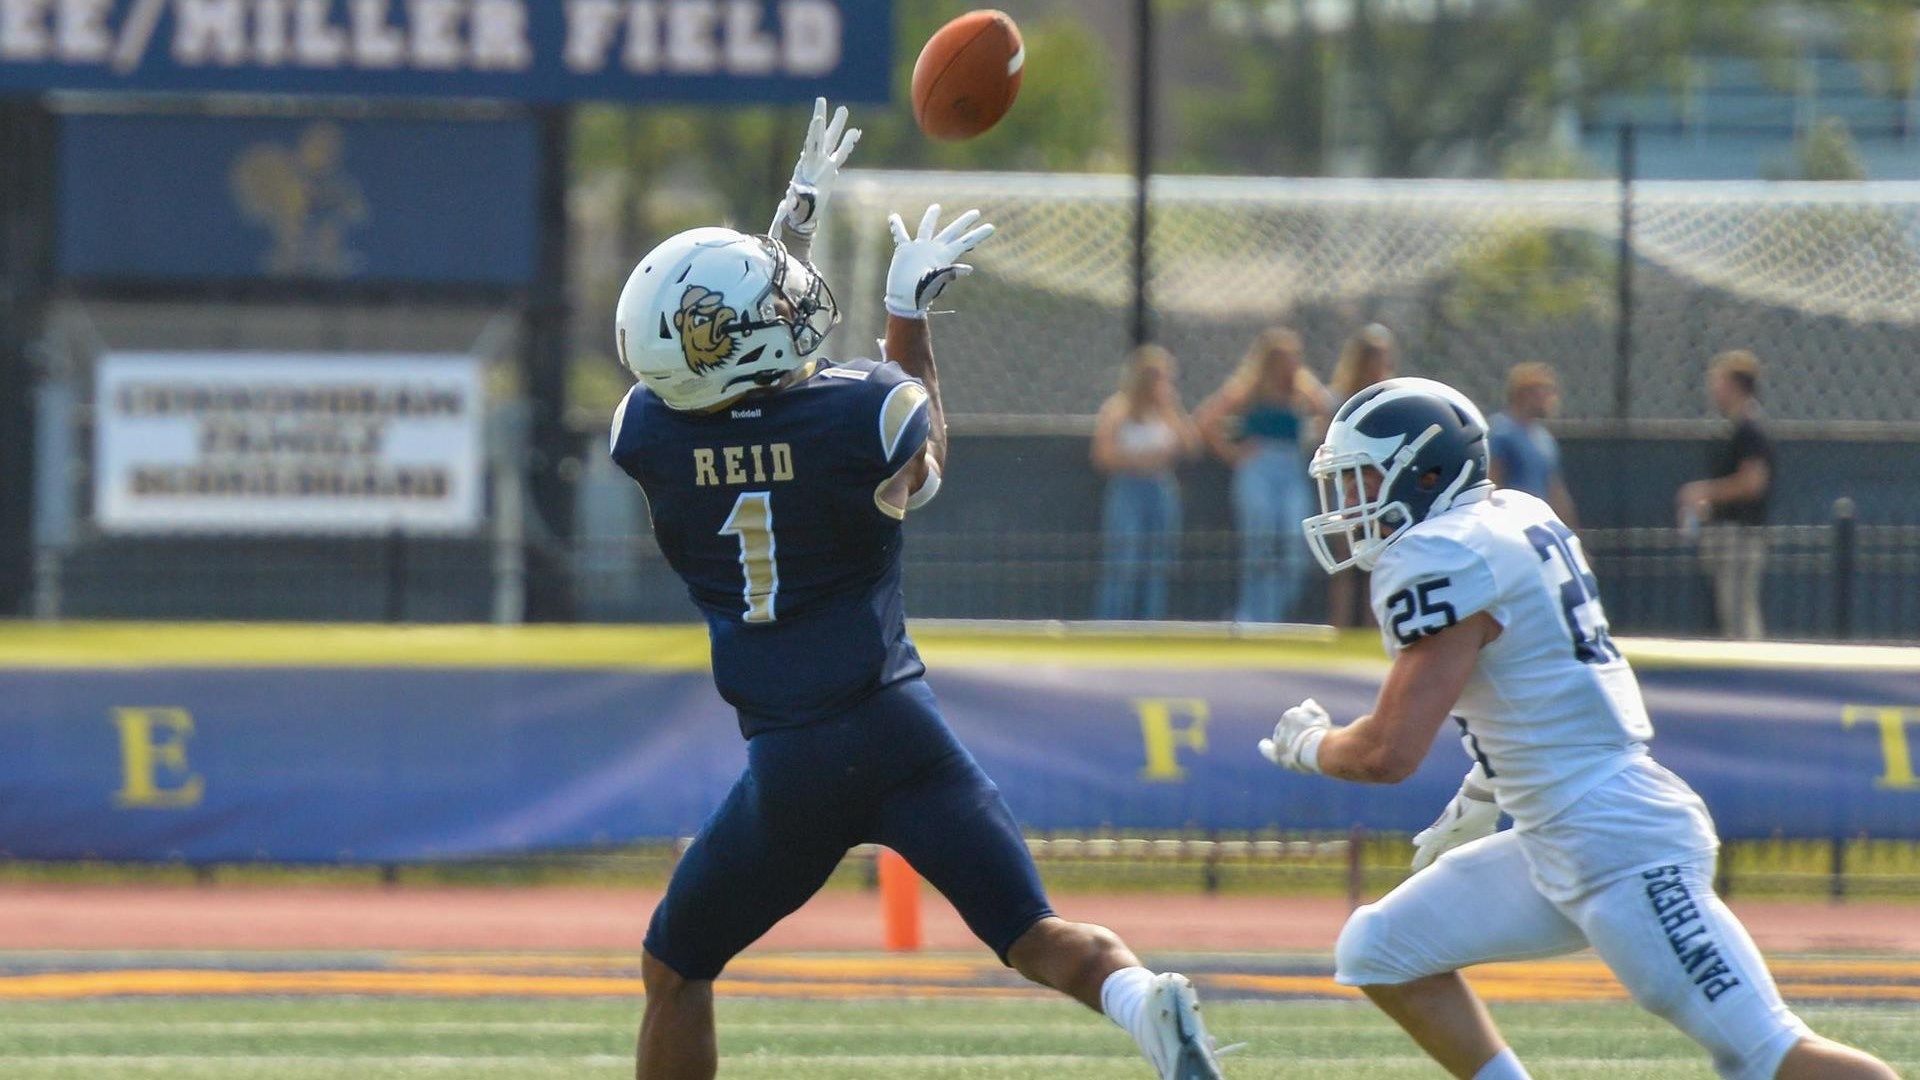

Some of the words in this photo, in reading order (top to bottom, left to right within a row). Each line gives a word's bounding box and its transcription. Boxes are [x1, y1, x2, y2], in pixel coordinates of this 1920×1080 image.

[562, 0, 842, 76] FIELD
[731, 409, 762, 419] Riddell
[693, 442, 795, 486] REID
[717, 490, 779, 622] 1
[1386, 576, 1458, 645] 25
[109, 706, 204, 808] E
[1136, 698, 1209, 781] F
[1842, 705, 1920, 788] T
[1642, 865, 1740, 1002] PANTHERS
